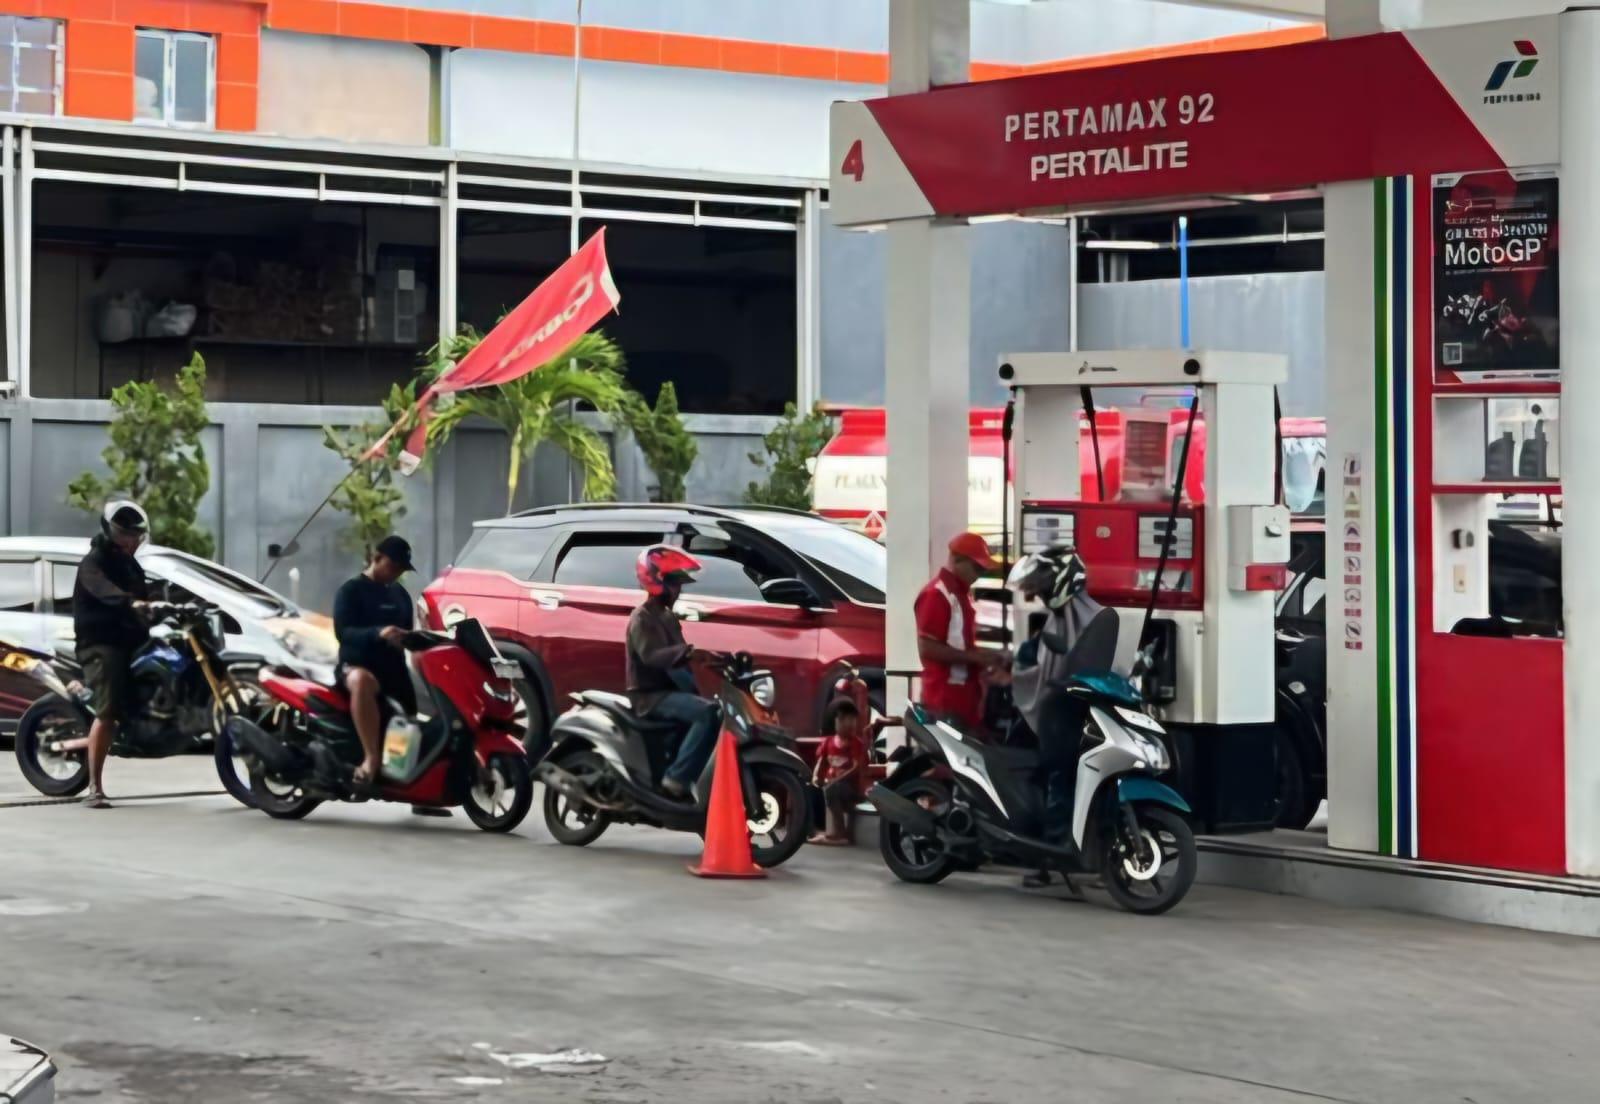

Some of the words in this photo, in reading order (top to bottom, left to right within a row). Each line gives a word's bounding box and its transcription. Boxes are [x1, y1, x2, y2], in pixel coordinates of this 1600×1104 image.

[1004, 98, 1168, 142] PERTAMAX
[1178, 92, 1215, 125] 92
[841, 139, 865, 182] 4
[1030, 141, 1189, 182] PERTALITE
[1445, 238, 1541, 266] MotoGP
